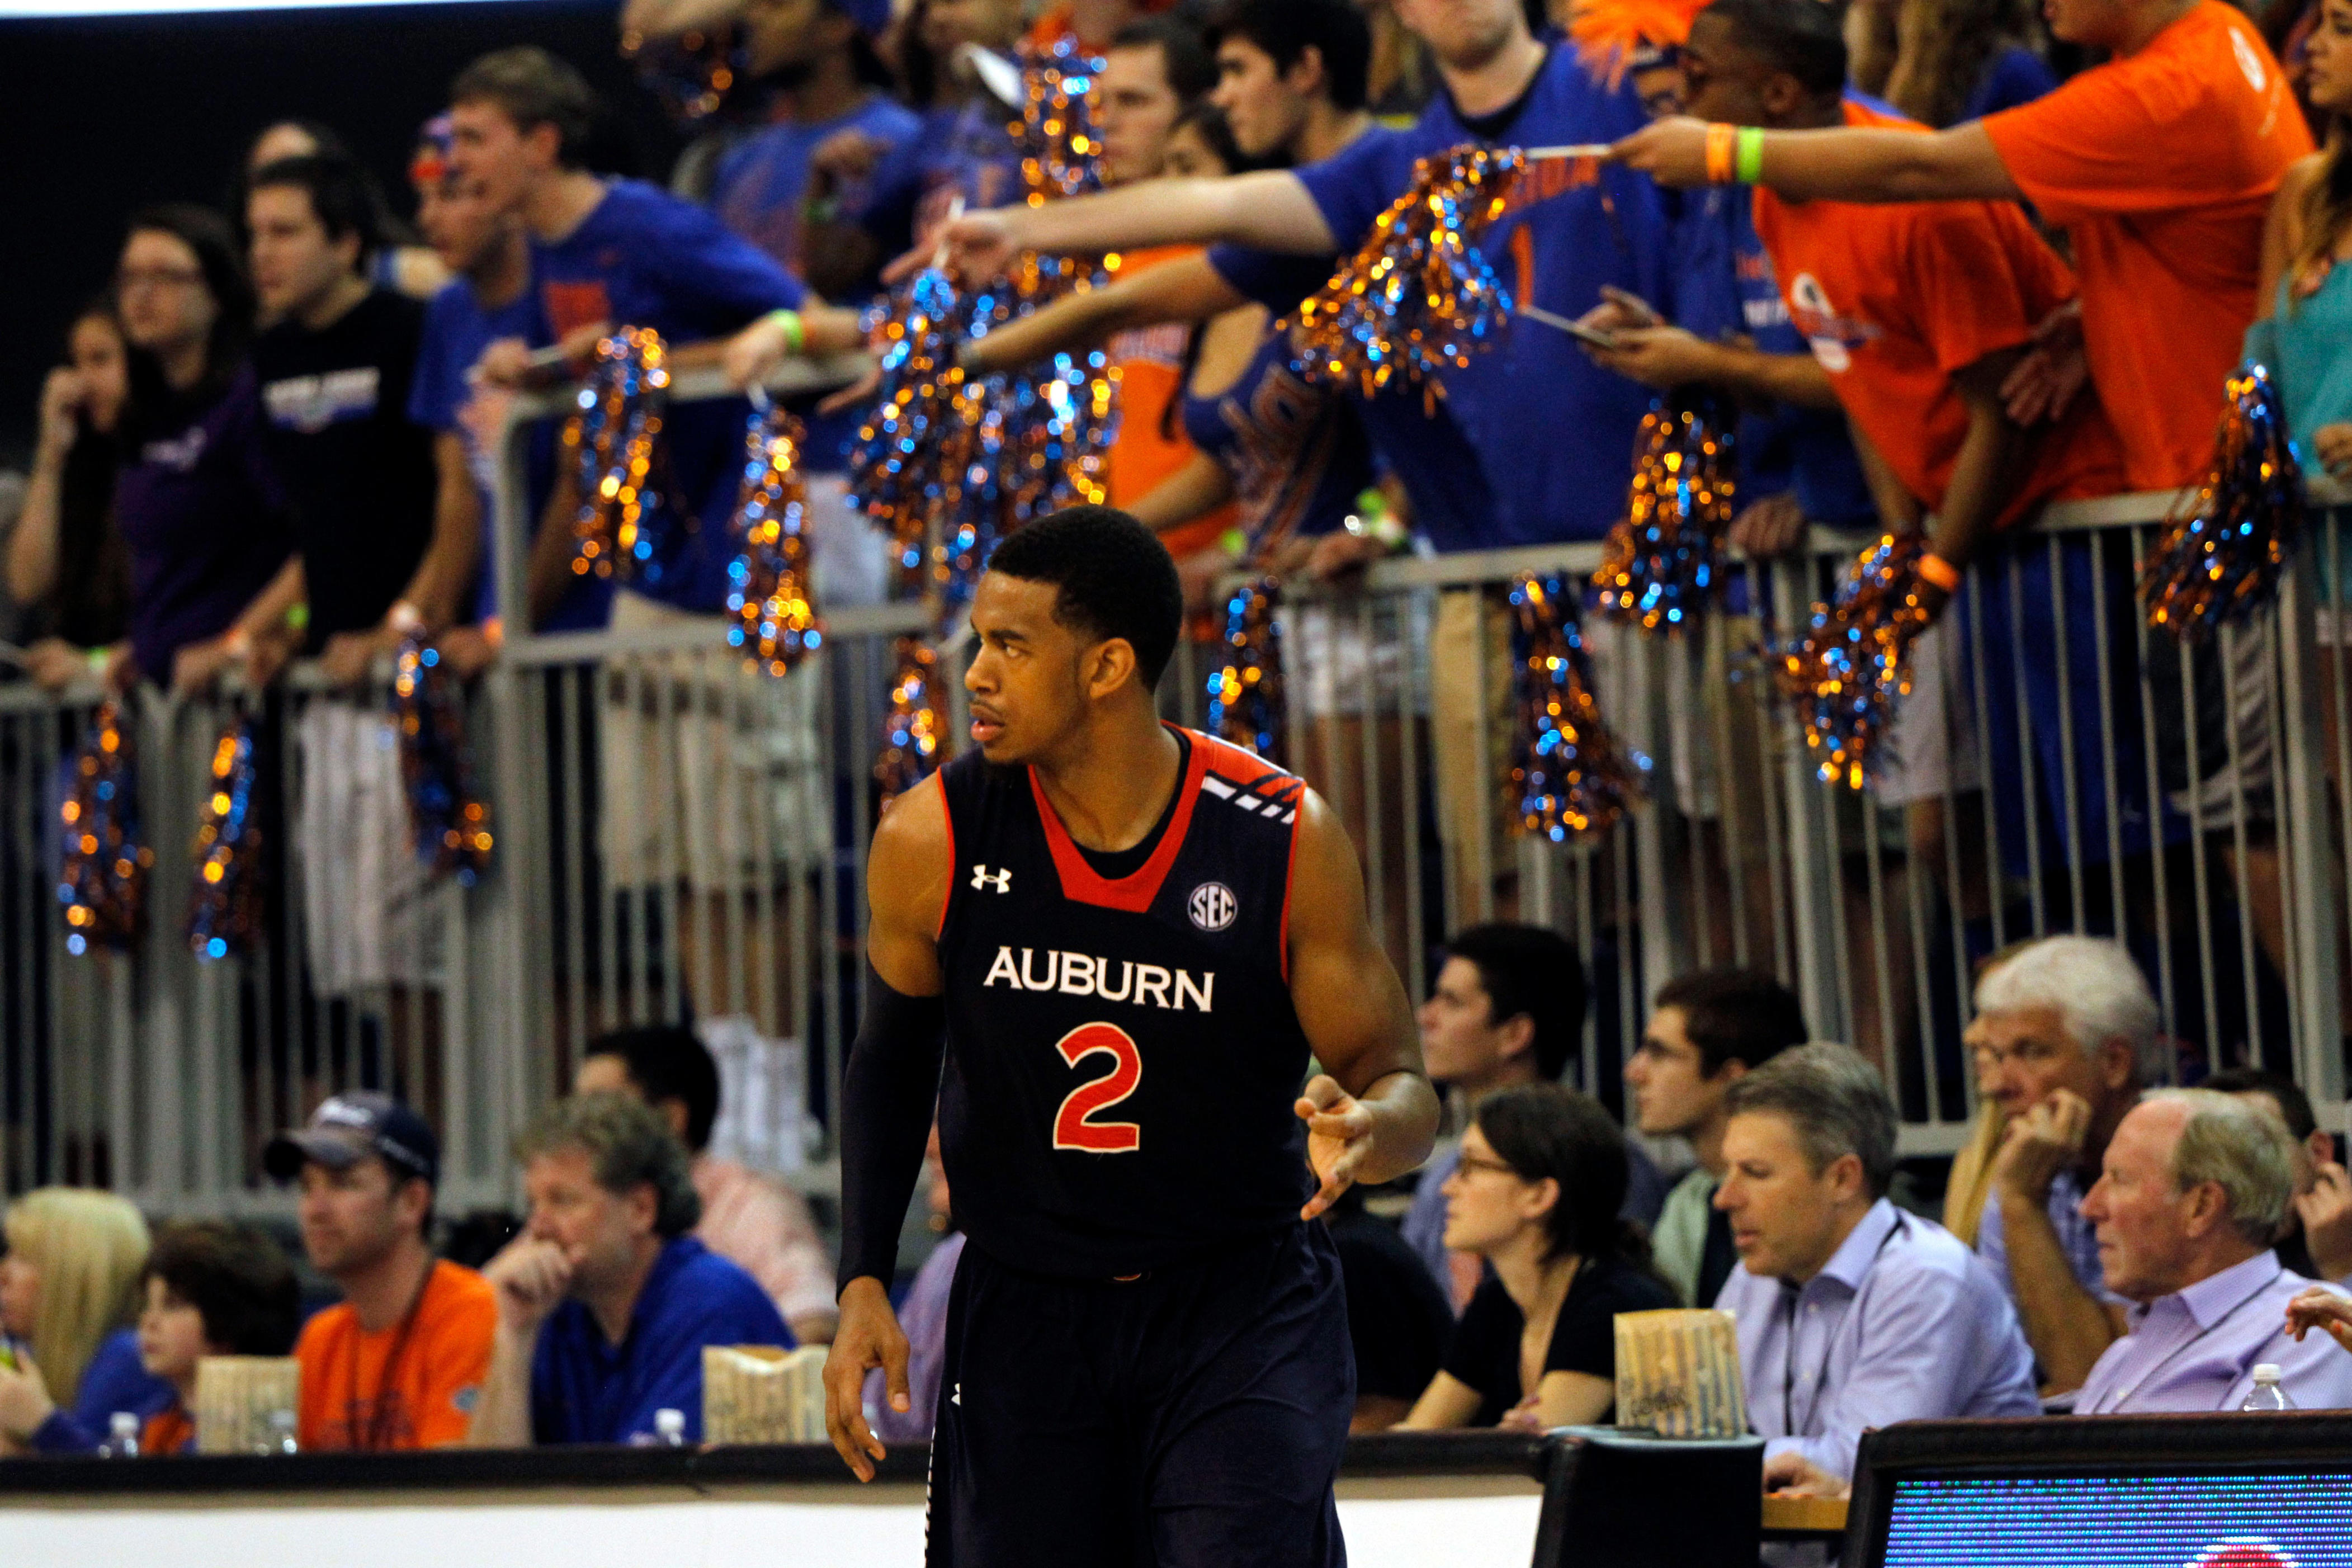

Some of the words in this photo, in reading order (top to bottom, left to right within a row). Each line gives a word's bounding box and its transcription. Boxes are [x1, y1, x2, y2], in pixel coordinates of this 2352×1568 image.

[1192, 885, 1234, 928] SEC
[983, 946, 1215, 1012] AUBURN
[1053, 1021, 1142, 1153] 2
